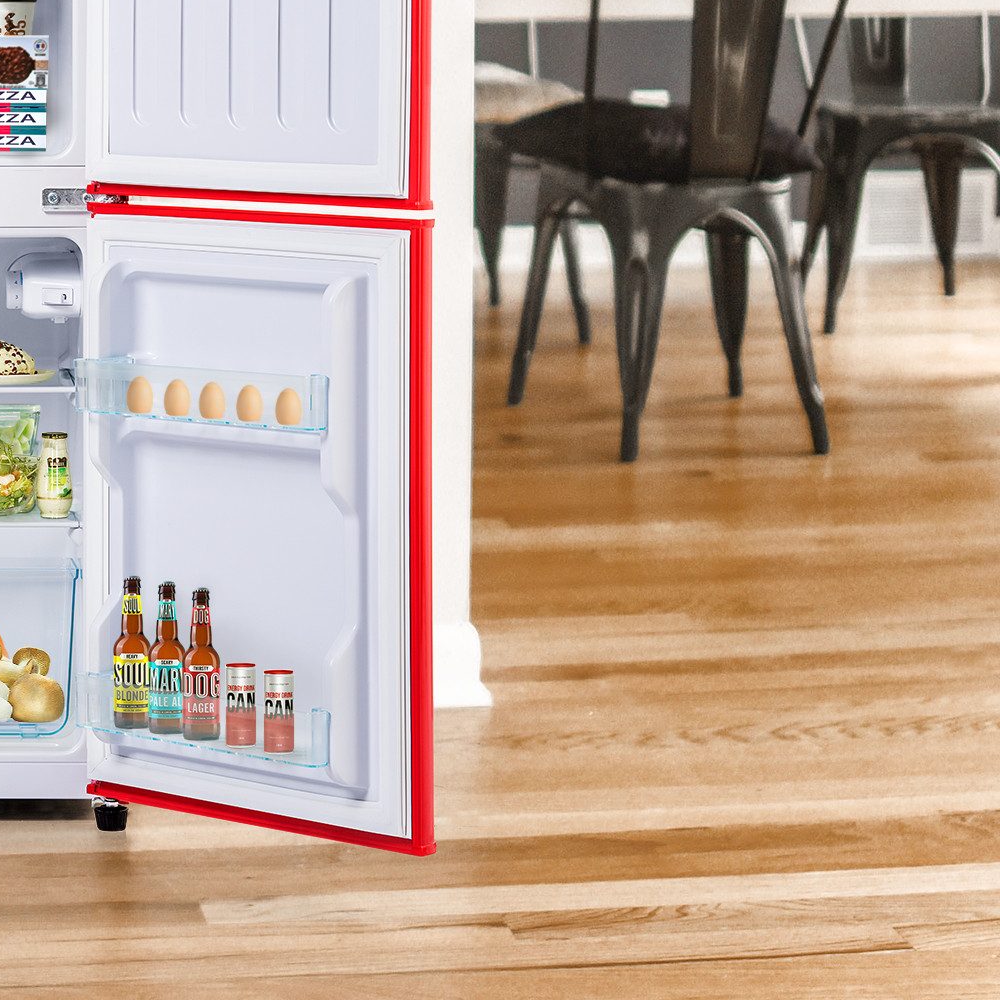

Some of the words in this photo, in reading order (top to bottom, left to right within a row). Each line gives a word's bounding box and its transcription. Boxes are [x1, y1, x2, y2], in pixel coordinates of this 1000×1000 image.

[123, 598, 141, 613] SOUL
[192, 609, 210, 625] DOG
[183, 672, 220, 698] DOG
[116, 690, 149, 701] BLONDE
[149, 696, 169, 707] PALE
[171, 696, 183, 707] AL
[227, 692, 256, 713] CAN
[187, 702, 215, 713] LAGER
[265, 699, 294, 720] CAN
